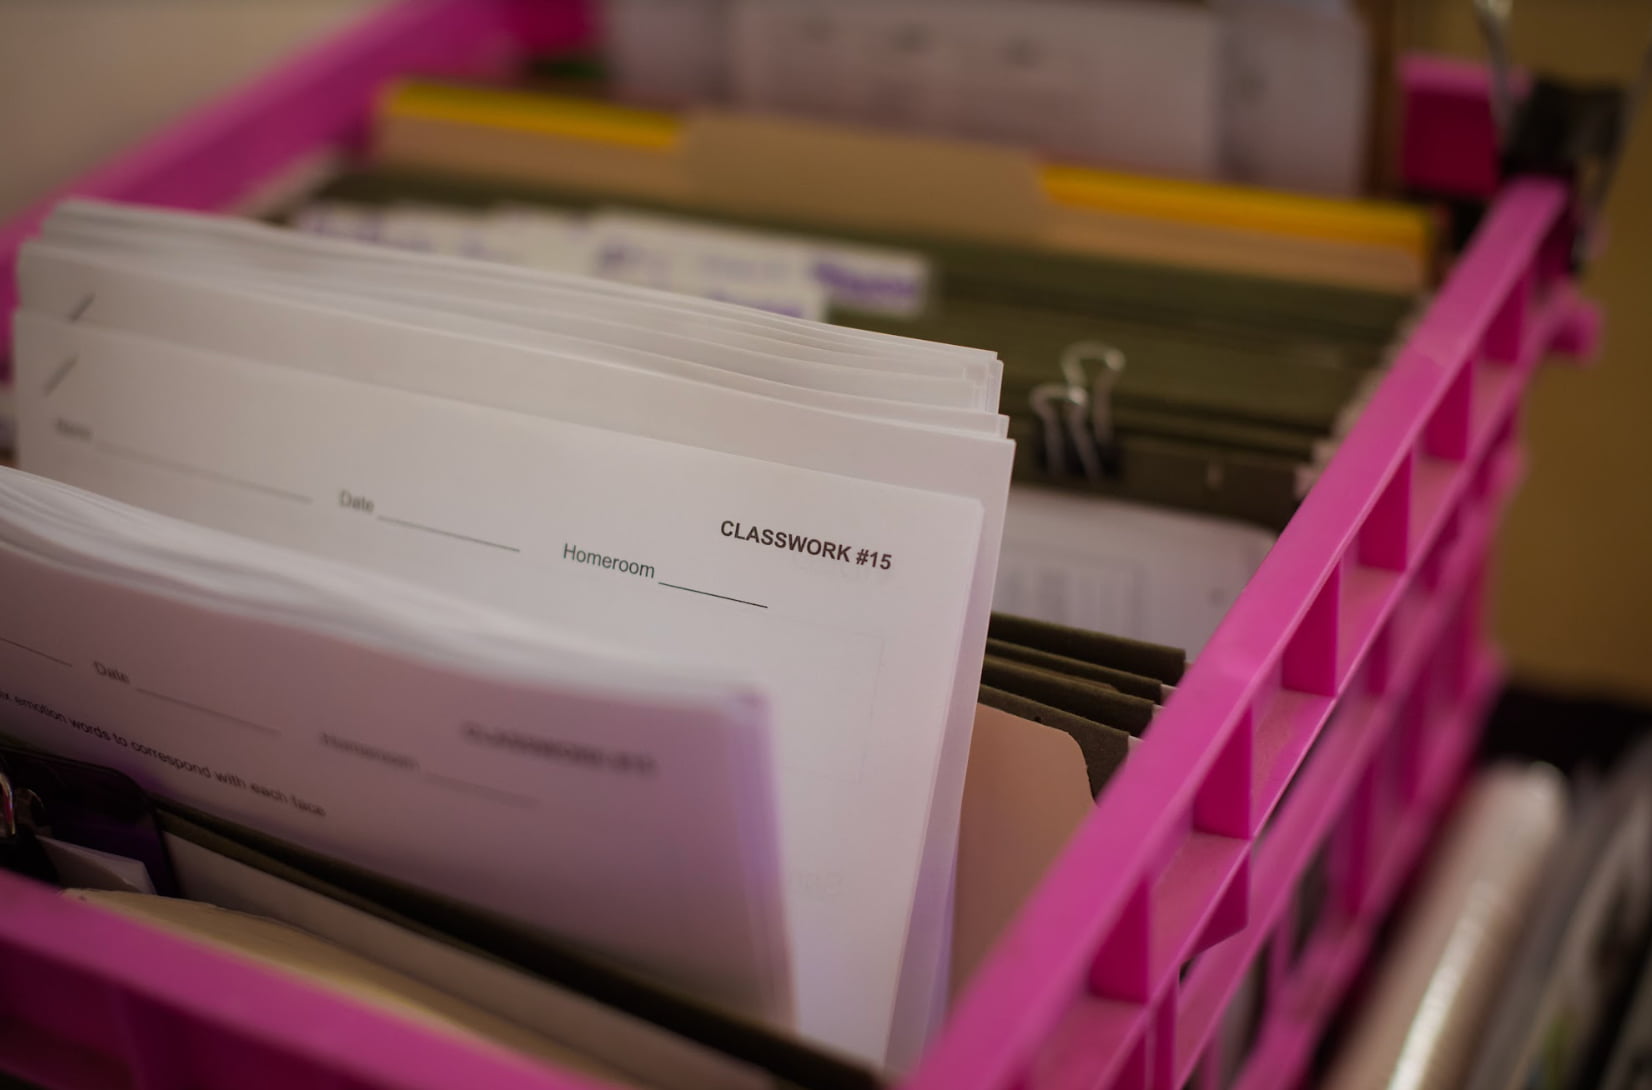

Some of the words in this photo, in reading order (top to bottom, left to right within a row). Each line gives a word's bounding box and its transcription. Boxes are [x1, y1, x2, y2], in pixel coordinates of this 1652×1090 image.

[338, 490, 375, 515] Date
[563, 543, 656, 579] Homeroom
[719, 520, 851, 563] CLASSWORK
[855, 548, 892, 571] #15
[68, 717, 111, 741] words
[112, 731, 129, 747] to
[131, 740, 212, 778] correspond
[214, 769, 246, 788] with
[250, 781, 289, 801] each
